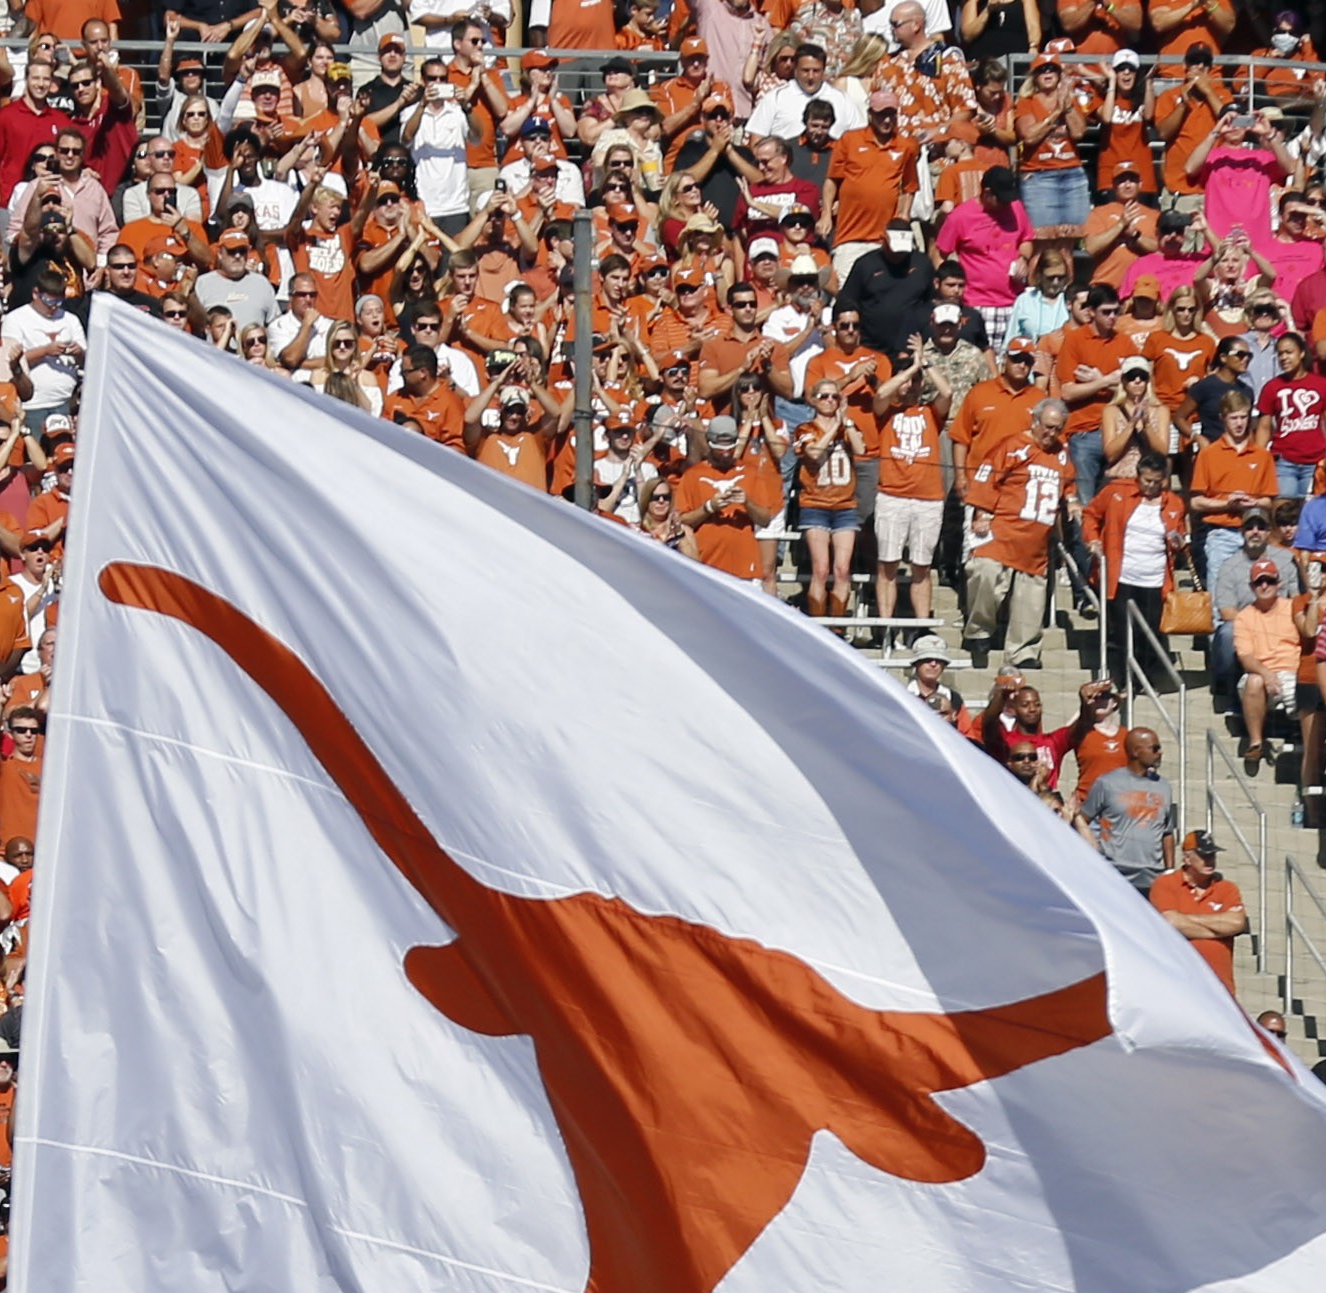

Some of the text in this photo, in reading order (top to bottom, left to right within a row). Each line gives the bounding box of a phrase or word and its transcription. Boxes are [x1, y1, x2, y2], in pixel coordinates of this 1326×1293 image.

[532, 116, 543, 126] T
[1276, 389, 1294, 417] I
[817, 448, 852, 486] 10
[1019, 478, 1060, 525] 12
